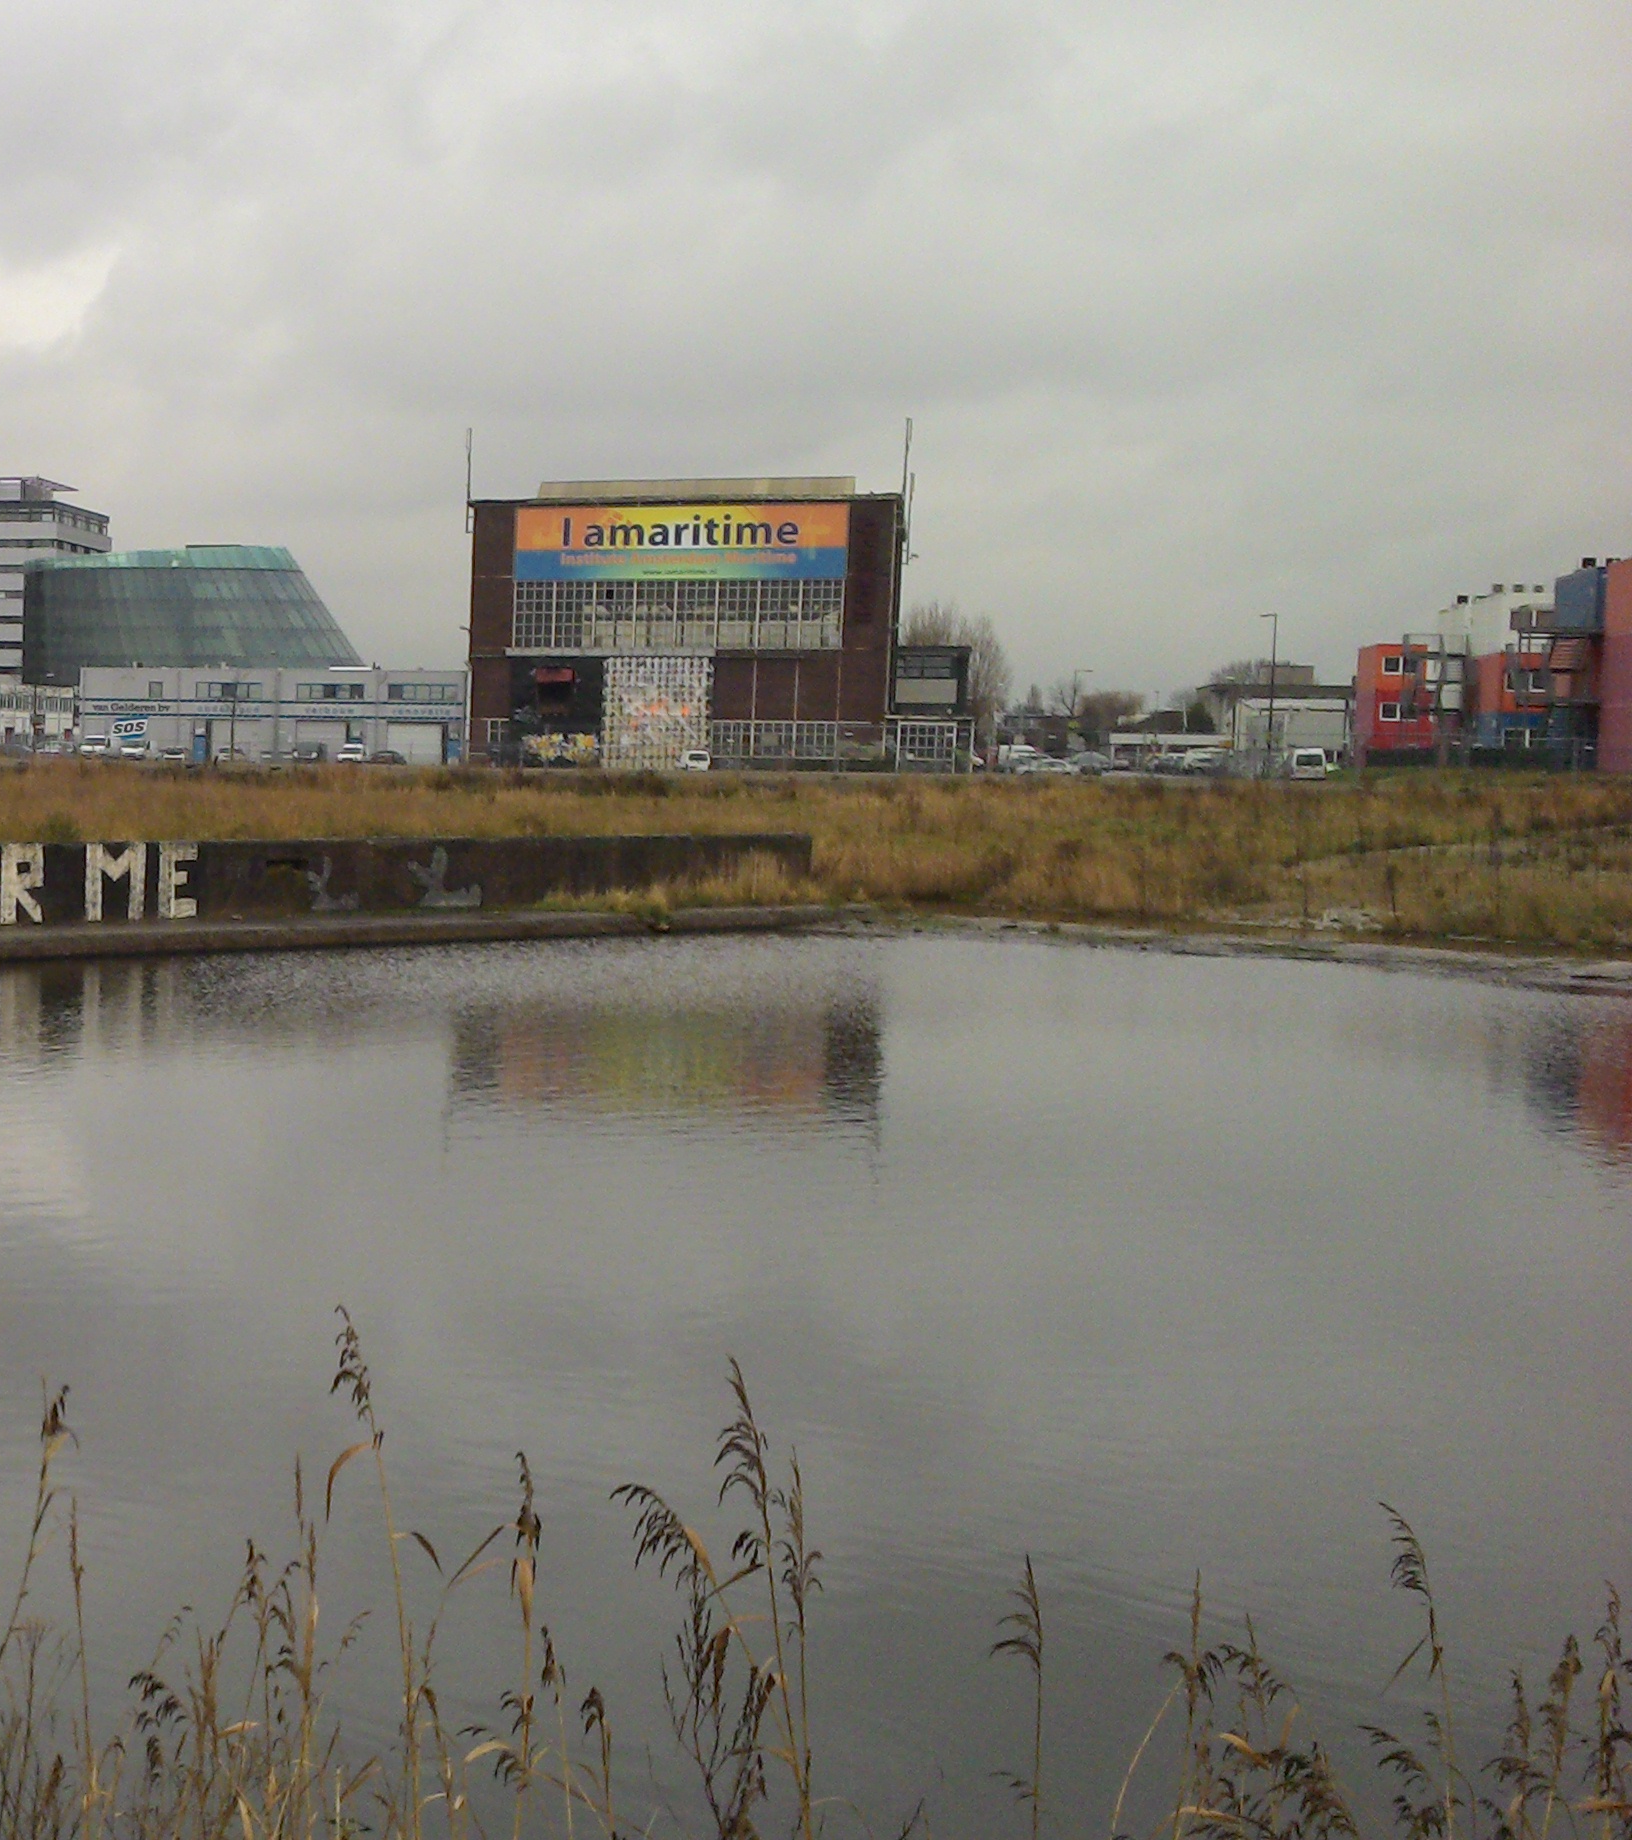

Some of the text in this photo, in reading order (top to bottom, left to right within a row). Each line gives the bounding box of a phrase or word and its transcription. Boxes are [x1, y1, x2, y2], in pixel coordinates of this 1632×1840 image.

[562, 514, 800, 548] I amaritime
[560, 551, 797, 566] Institute Amsterdam Maritime
[93, 703, 171, 712] van Gelderen bv
[85, 842, 200, 922] ME
